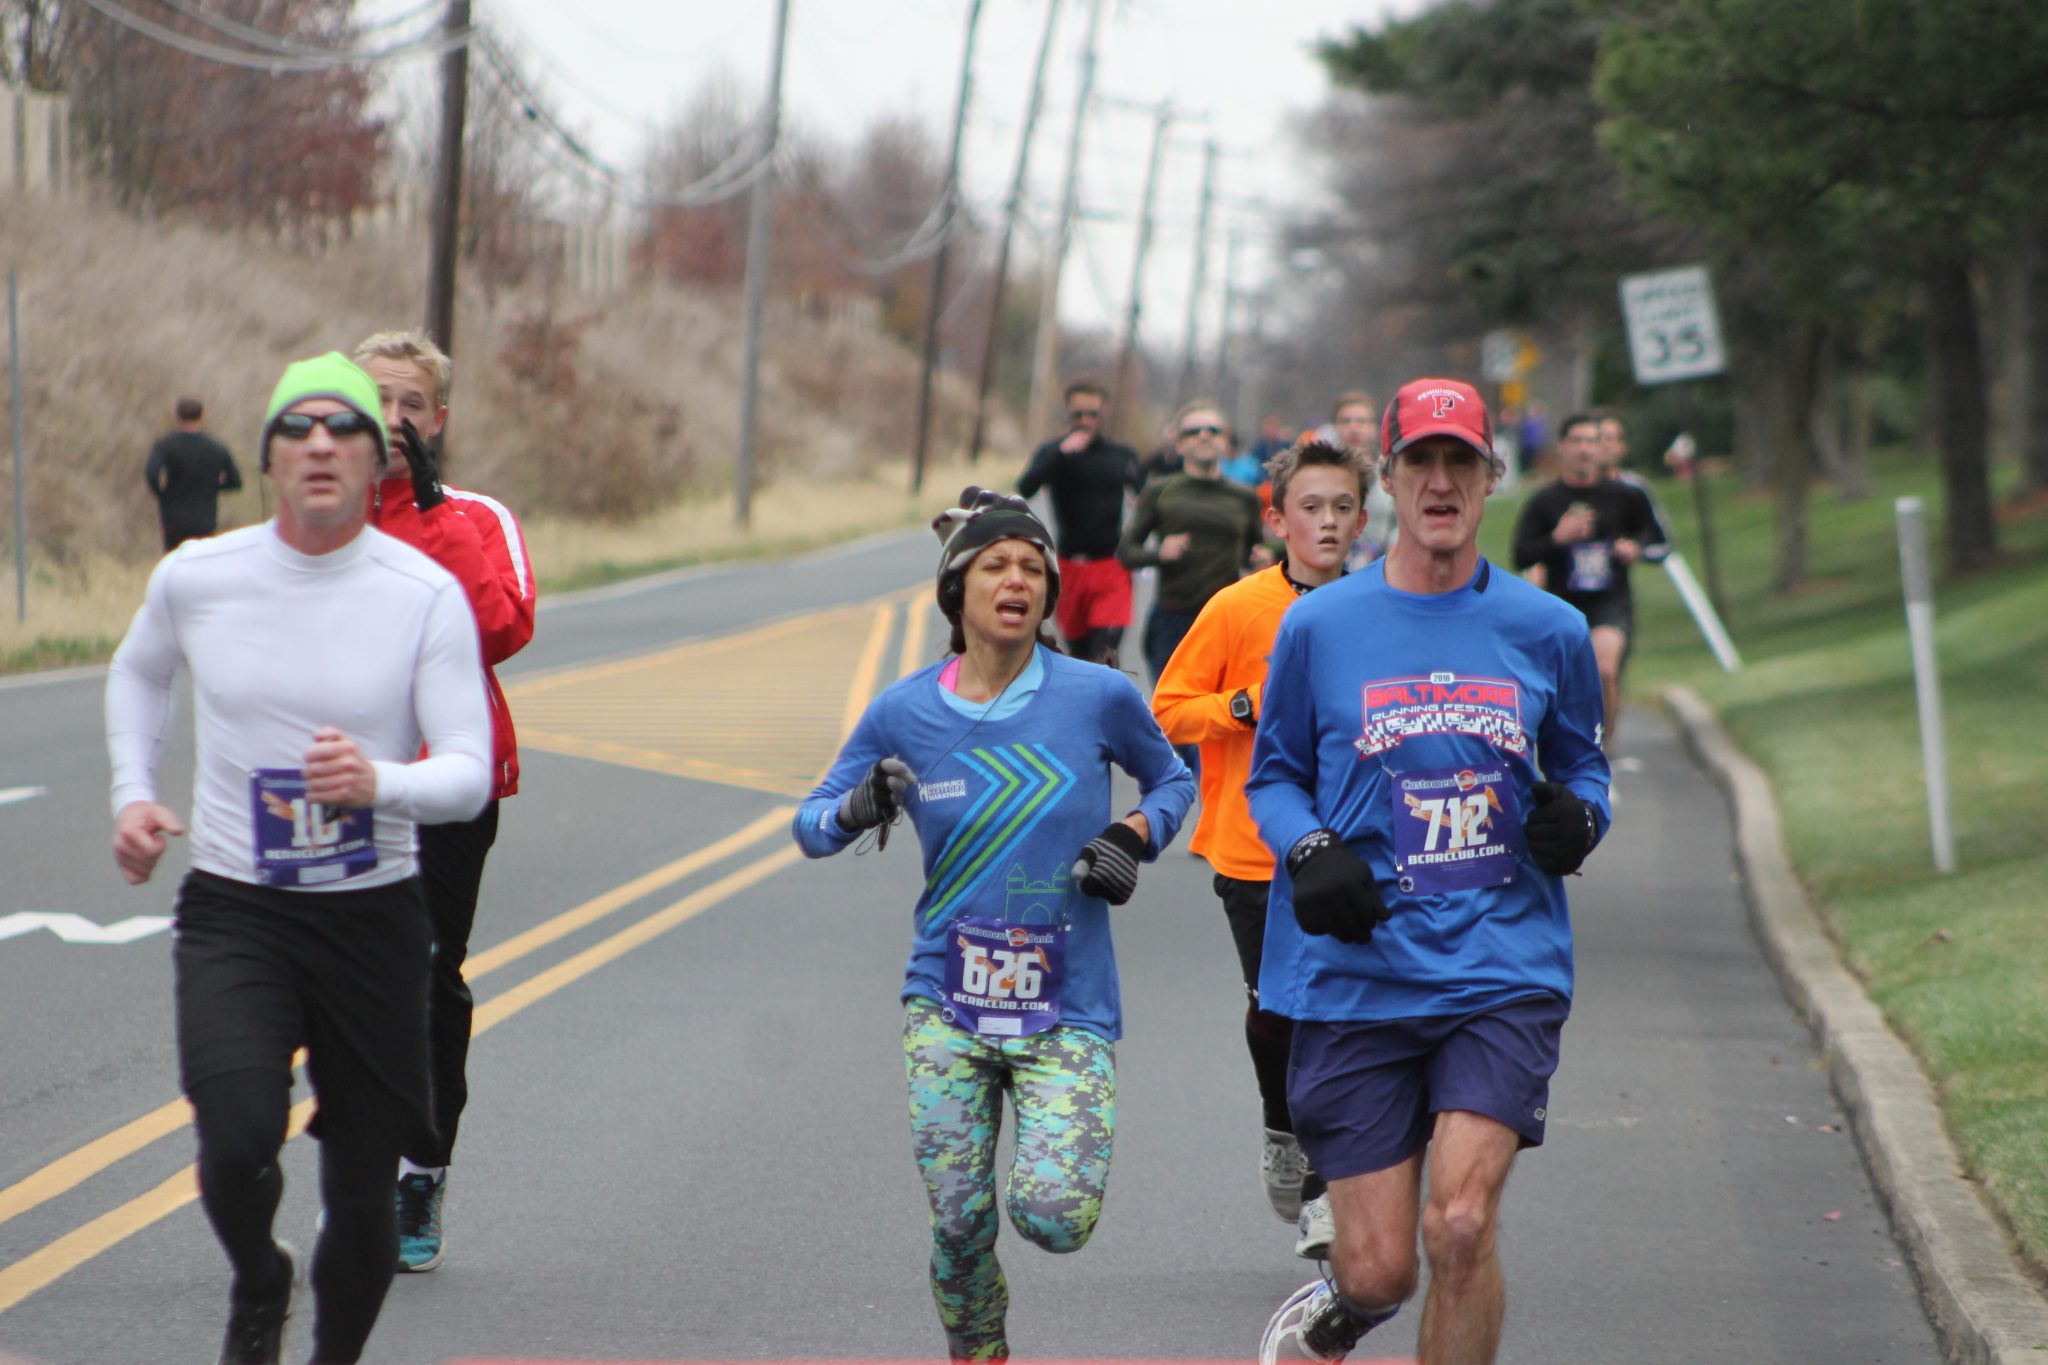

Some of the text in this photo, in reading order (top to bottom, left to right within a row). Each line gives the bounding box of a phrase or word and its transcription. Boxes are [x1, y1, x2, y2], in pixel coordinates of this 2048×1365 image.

[1646, 324, 1705, 368] 35
[1432, 394, 1455, 417] P
[1367, 684, 1515, 707] BALTIMORE
[1371, 703, 1514, 722] RUNNING FESTIVAL
[1401, 770, 1503, 790] Customers Bank
[928, 790, 966, 800] MARATHON
[1420, 794, 1489, 851] 712
[1408, 844, 1505, 865] BCRRCLUB.COM
[957, 923, 1054, 943] Customers Bank
[962, 945, 1042, 999] 626
[953, 992, 1049, 1011] BCRRCLUB.COM
